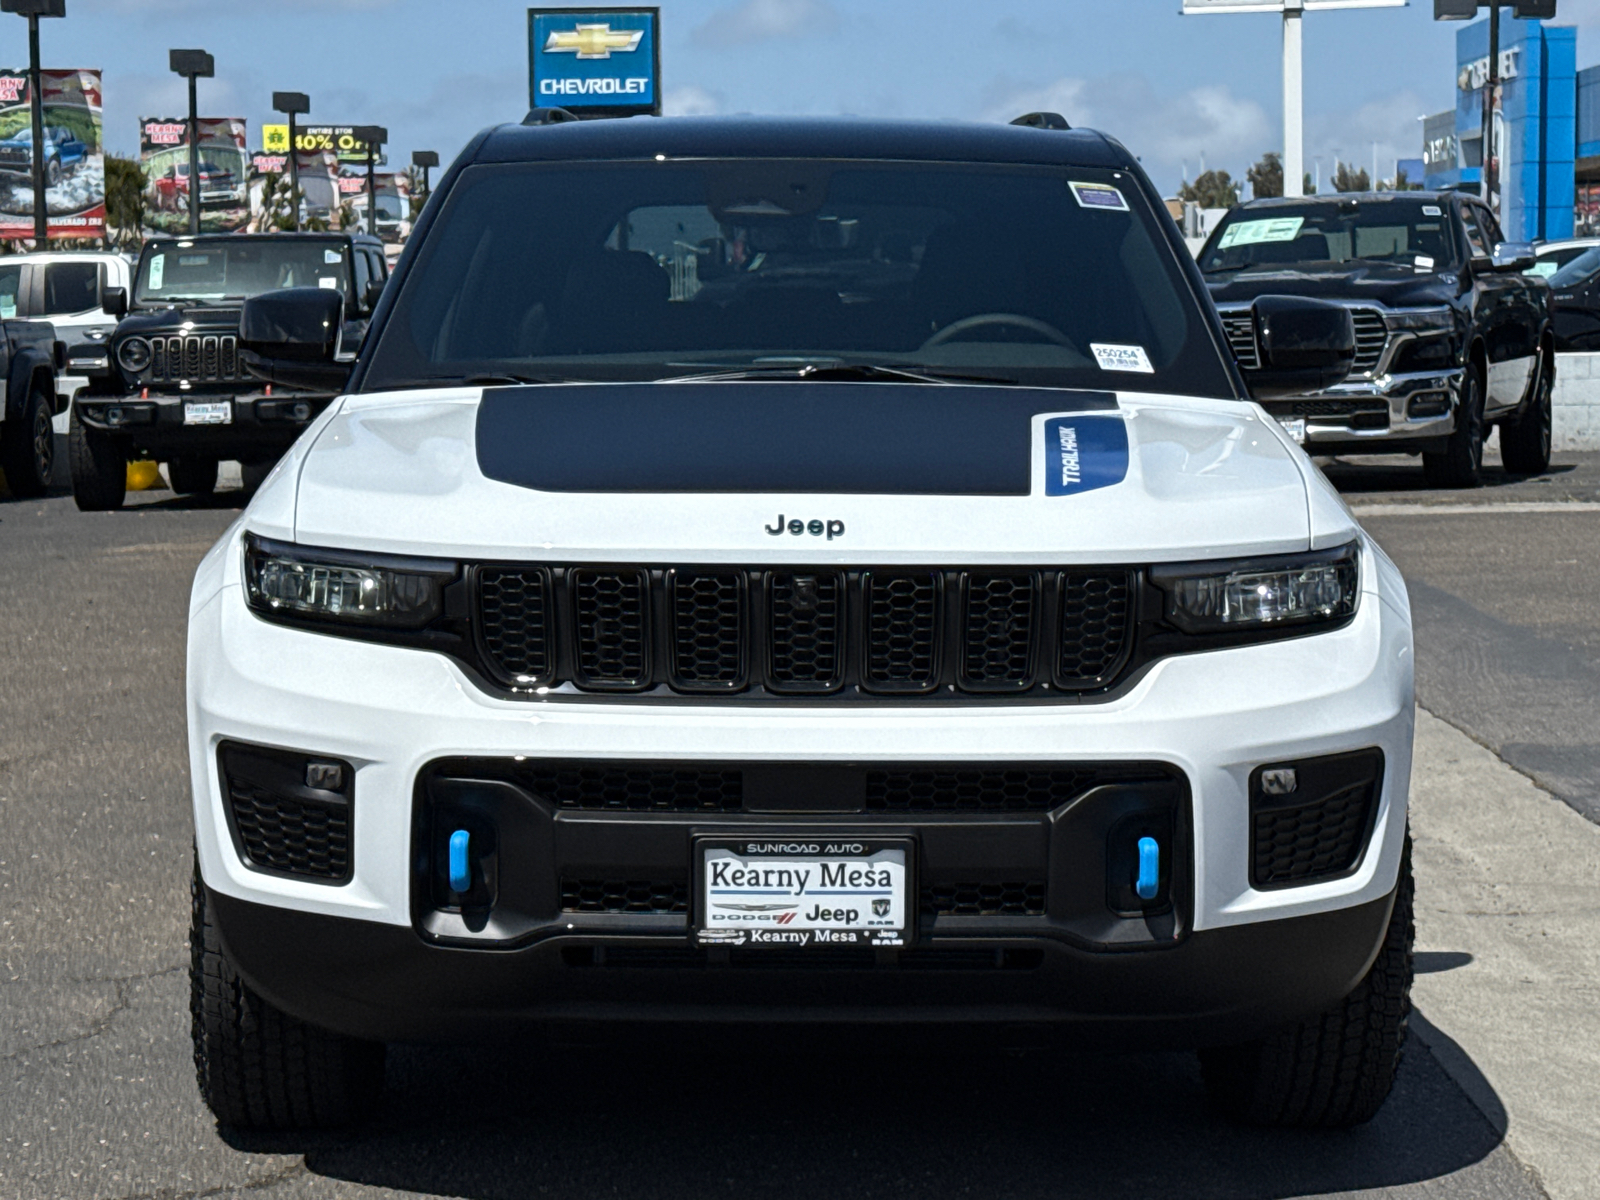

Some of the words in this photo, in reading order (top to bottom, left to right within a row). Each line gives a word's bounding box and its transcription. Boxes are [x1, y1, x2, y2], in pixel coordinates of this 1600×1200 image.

[541, 78, 648, 94] CHEVROLET
[145, 124, 186, 134] KEARNY
[151, 134, 180, 143] MESA
[1059, 426, 1081, 486] TRAILHAWK
[765, 514, 845, 541] Jeep
[747, 843, 820, 853] SUNROAD
[824, 843, 863, 853] AUTO
[711, 862, 810, 895] Kearny
[820, 863, 893, 887] Mesa
[806, 903, 859, 925] Jeep
[751, 930, 809, 946] Kearny
[814, 930, 858, 942] Mesa
[878, 930, 899, 938] Jeep
